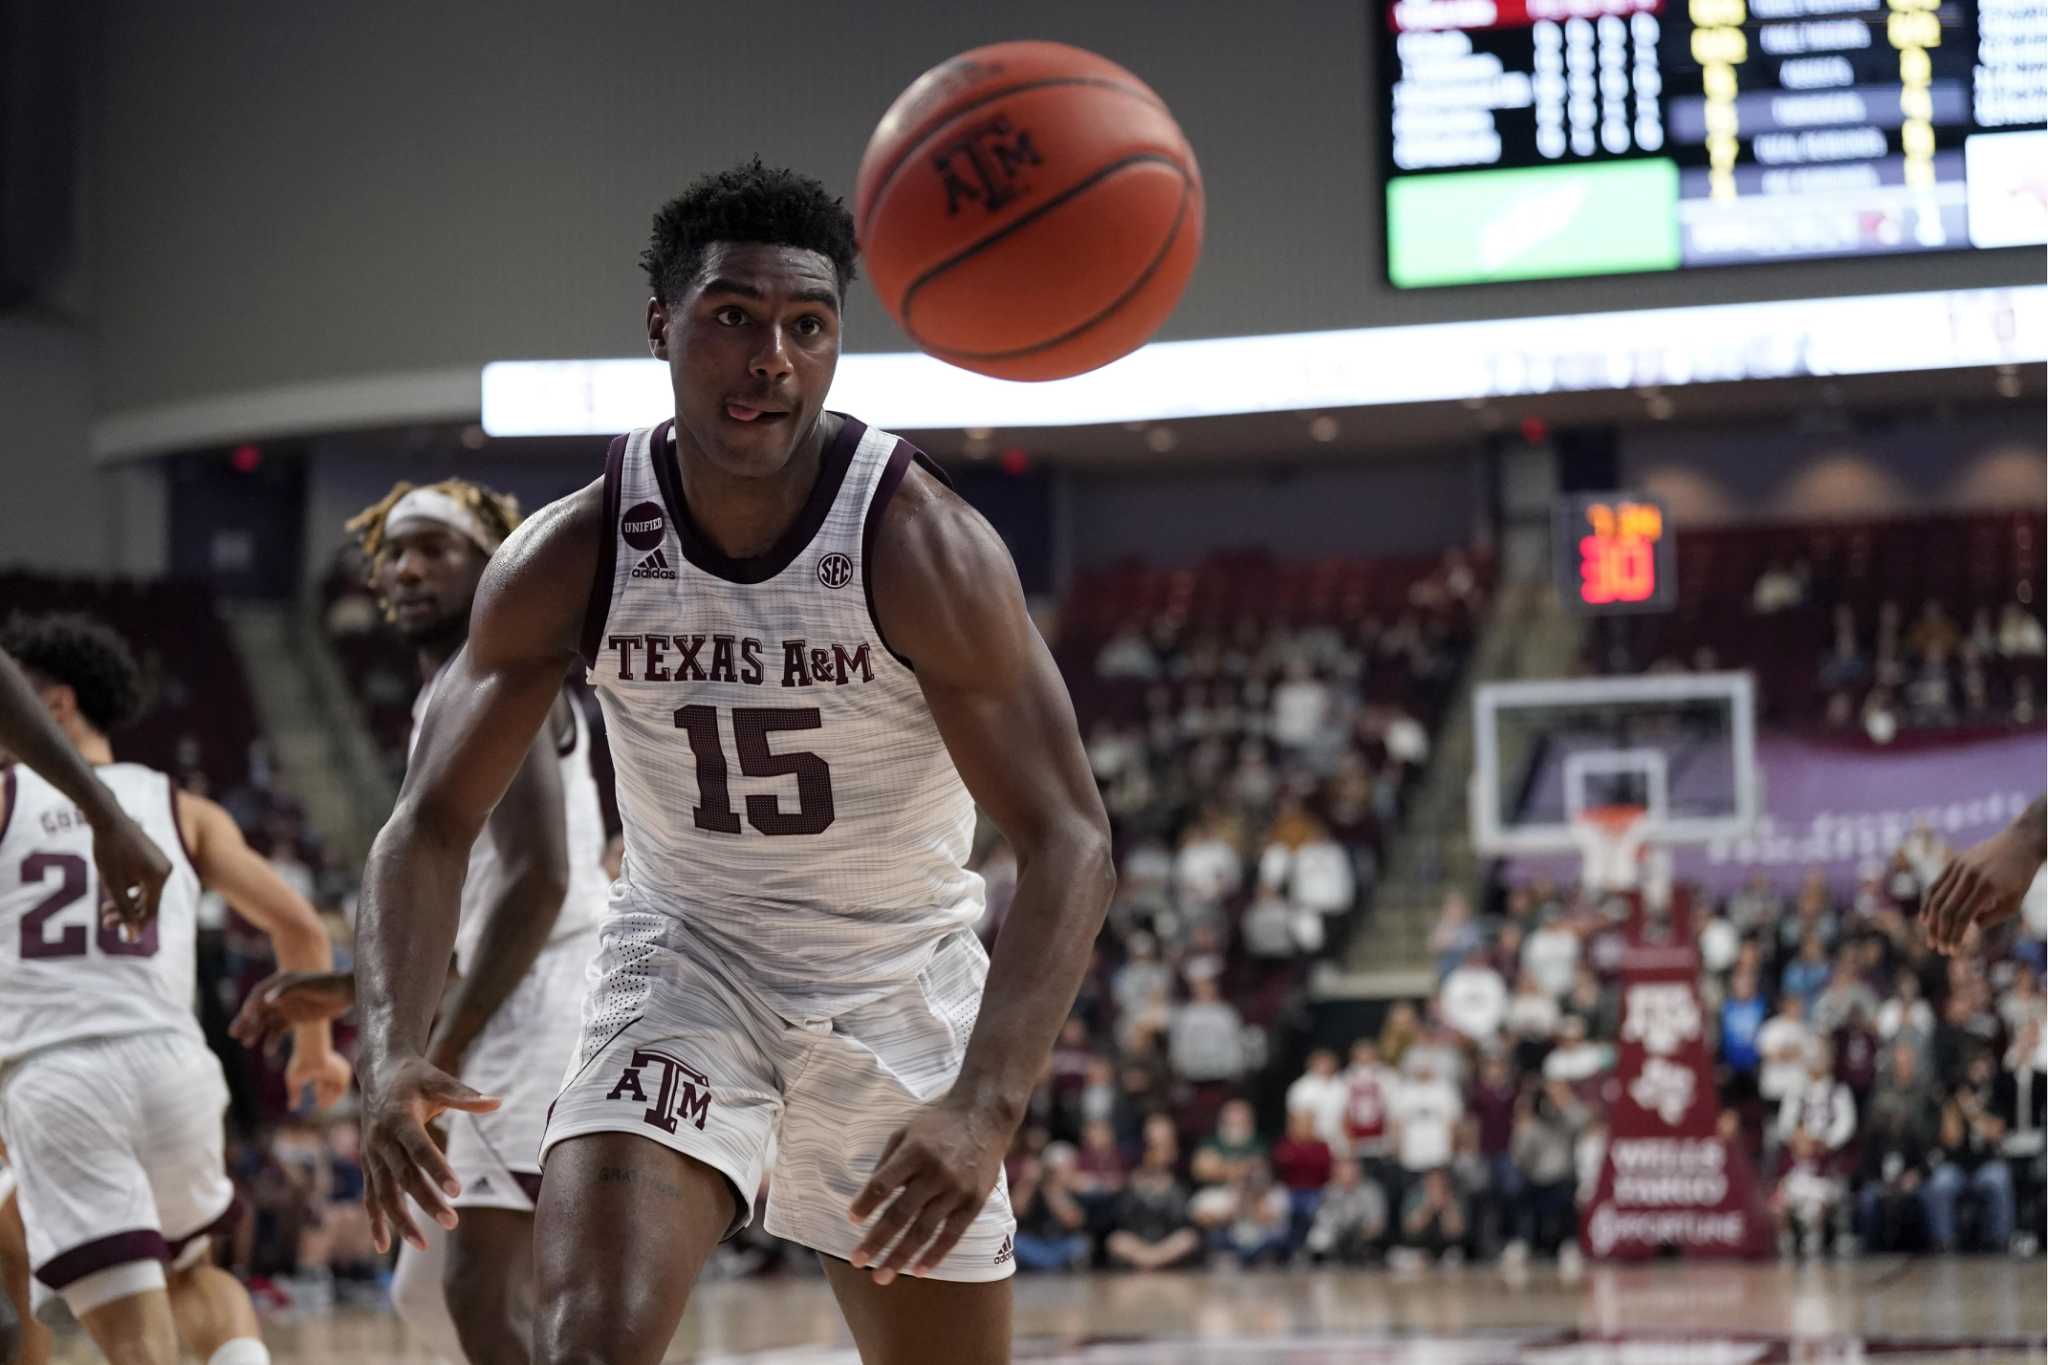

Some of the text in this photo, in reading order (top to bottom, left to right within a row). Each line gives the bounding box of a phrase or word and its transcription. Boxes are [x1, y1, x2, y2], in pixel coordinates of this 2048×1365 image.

[624, 517, 663, 533] UNIFIED
[632, 568, 676, 580] adidas
[820, 559, 850, 586] SEC
[608, 634, 876, 688] TEXAS A&M
[673, 704, 836, 837] 15
